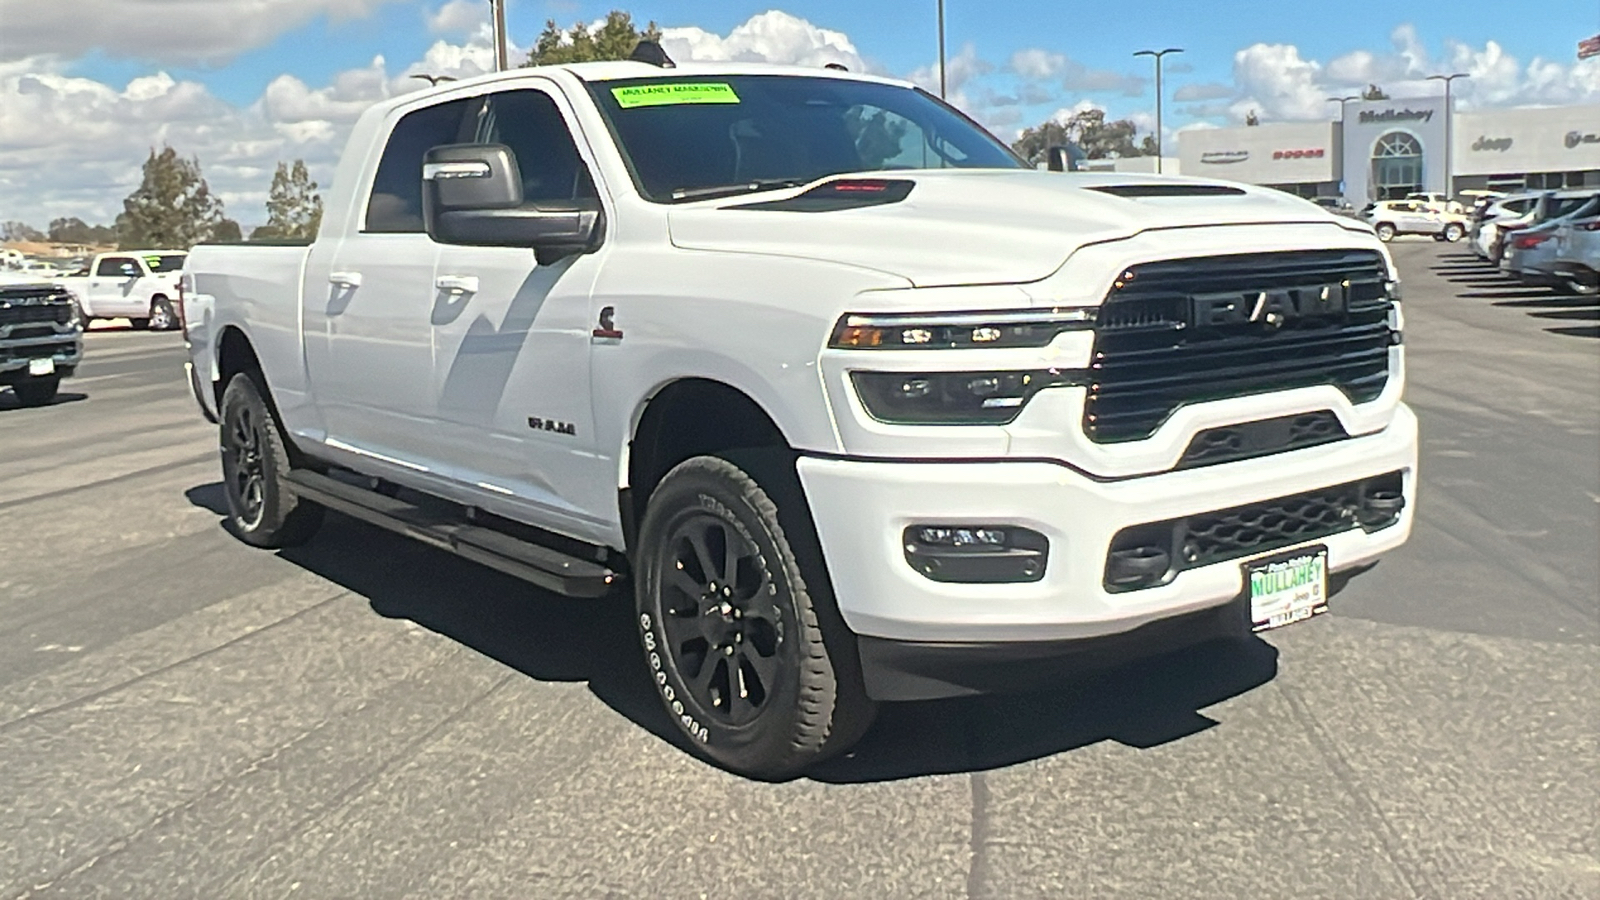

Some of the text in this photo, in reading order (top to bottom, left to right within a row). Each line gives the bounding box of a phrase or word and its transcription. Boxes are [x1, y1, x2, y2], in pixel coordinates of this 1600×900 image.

[1472, 135, 1513, 152] Jeep
[528, 417, 576, 436] RAM
[1253, 563, 1321, 597] MULLAHEY
